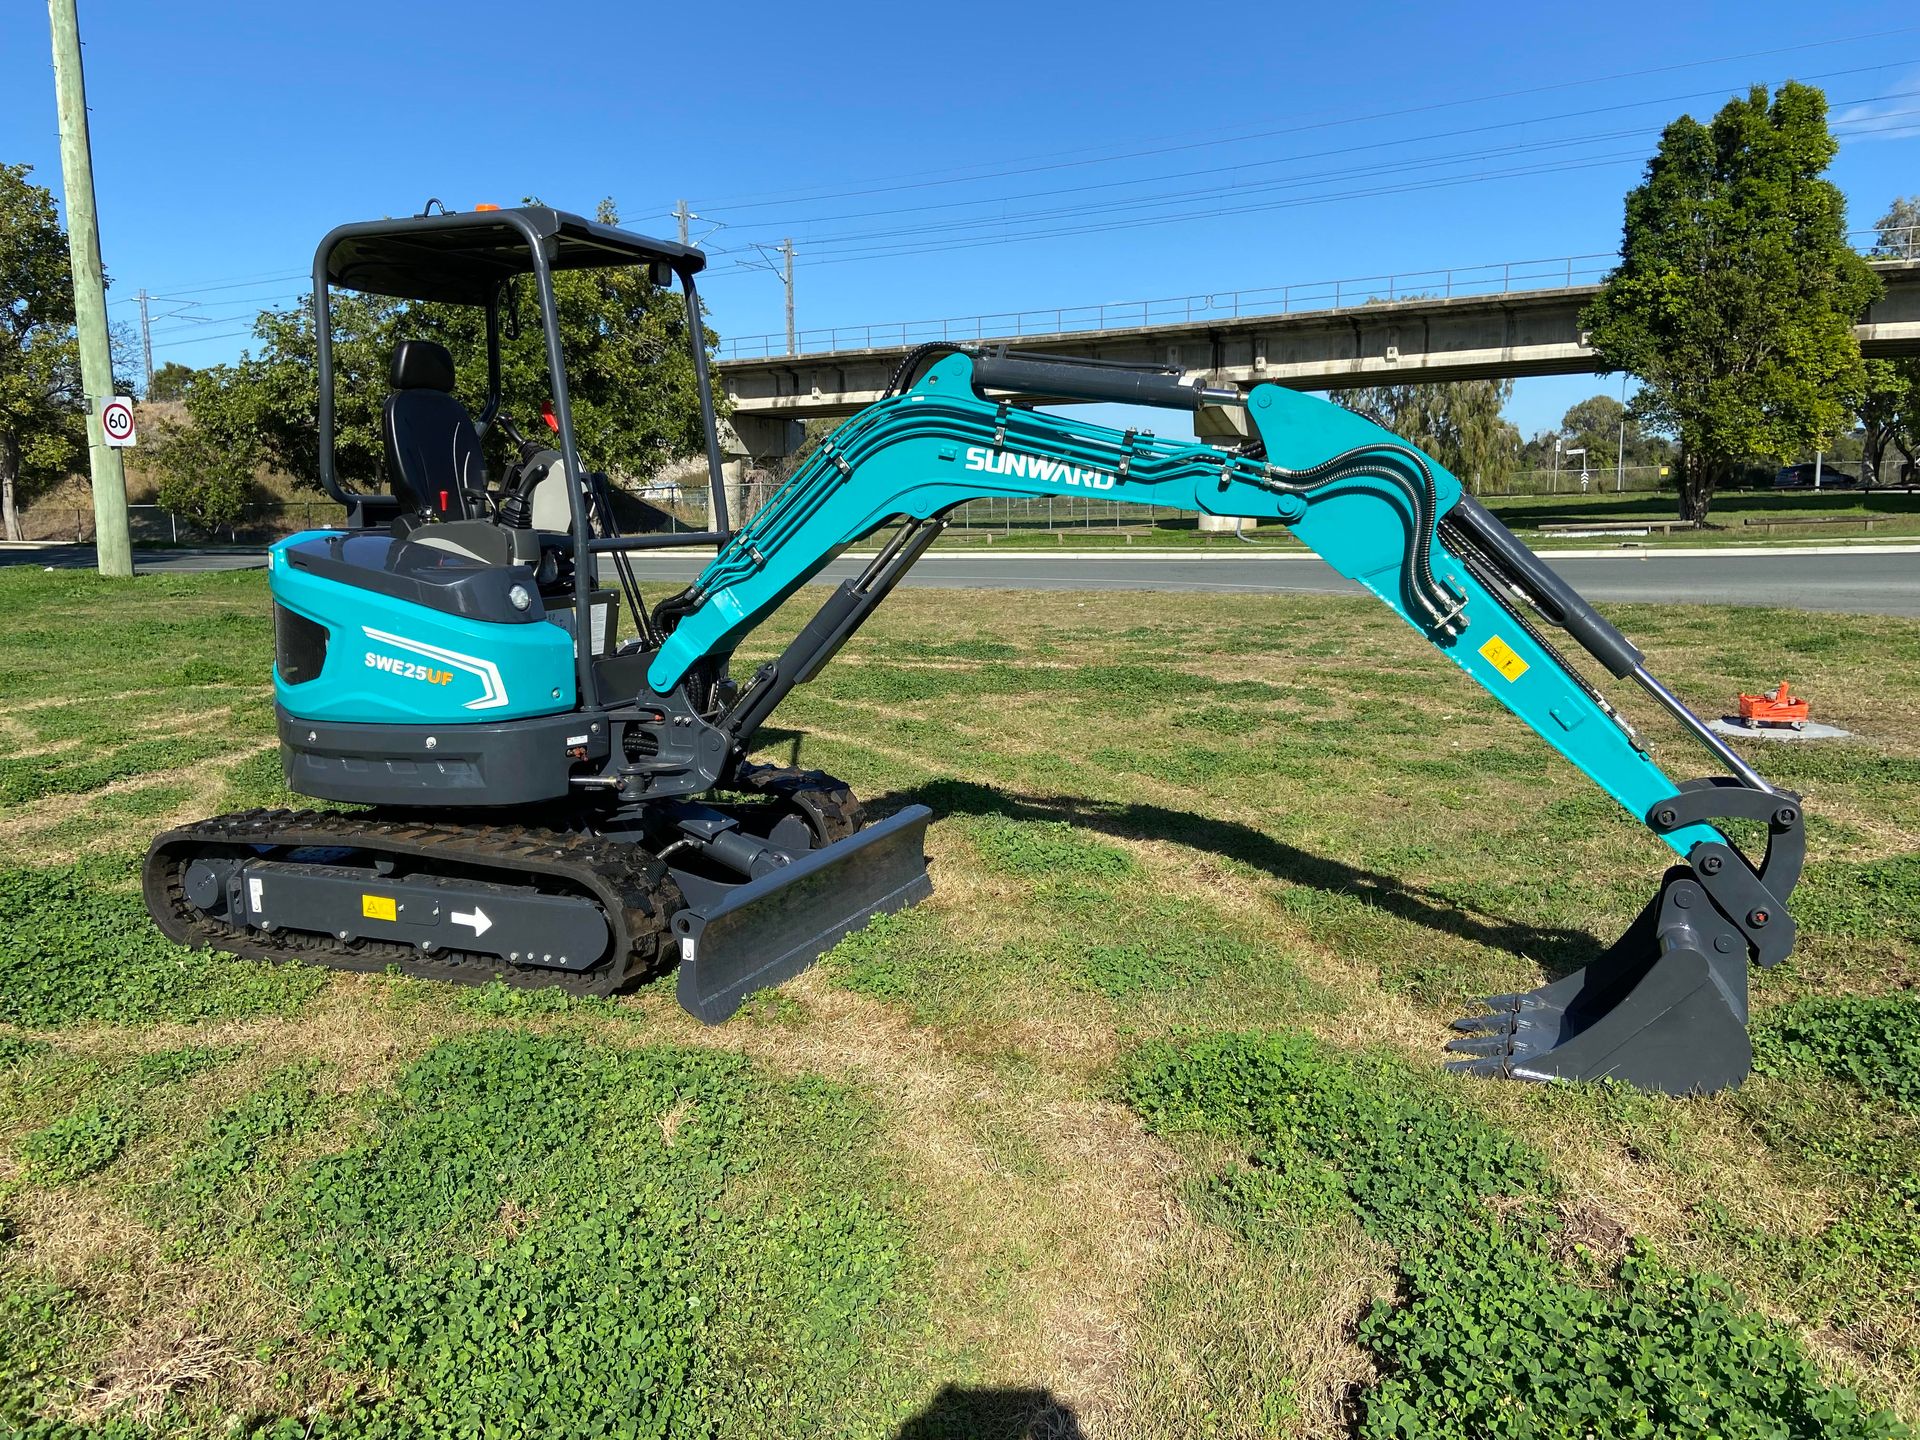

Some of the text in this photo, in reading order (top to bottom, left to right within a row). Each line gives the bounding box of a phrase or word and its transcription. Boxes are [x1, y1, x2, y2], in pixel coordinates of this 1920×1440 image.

[109, 413, 127, 429] 60
[965, 447, 1115, 490] SUNWARD
[364, 651, 454, 686] SWE25UF
